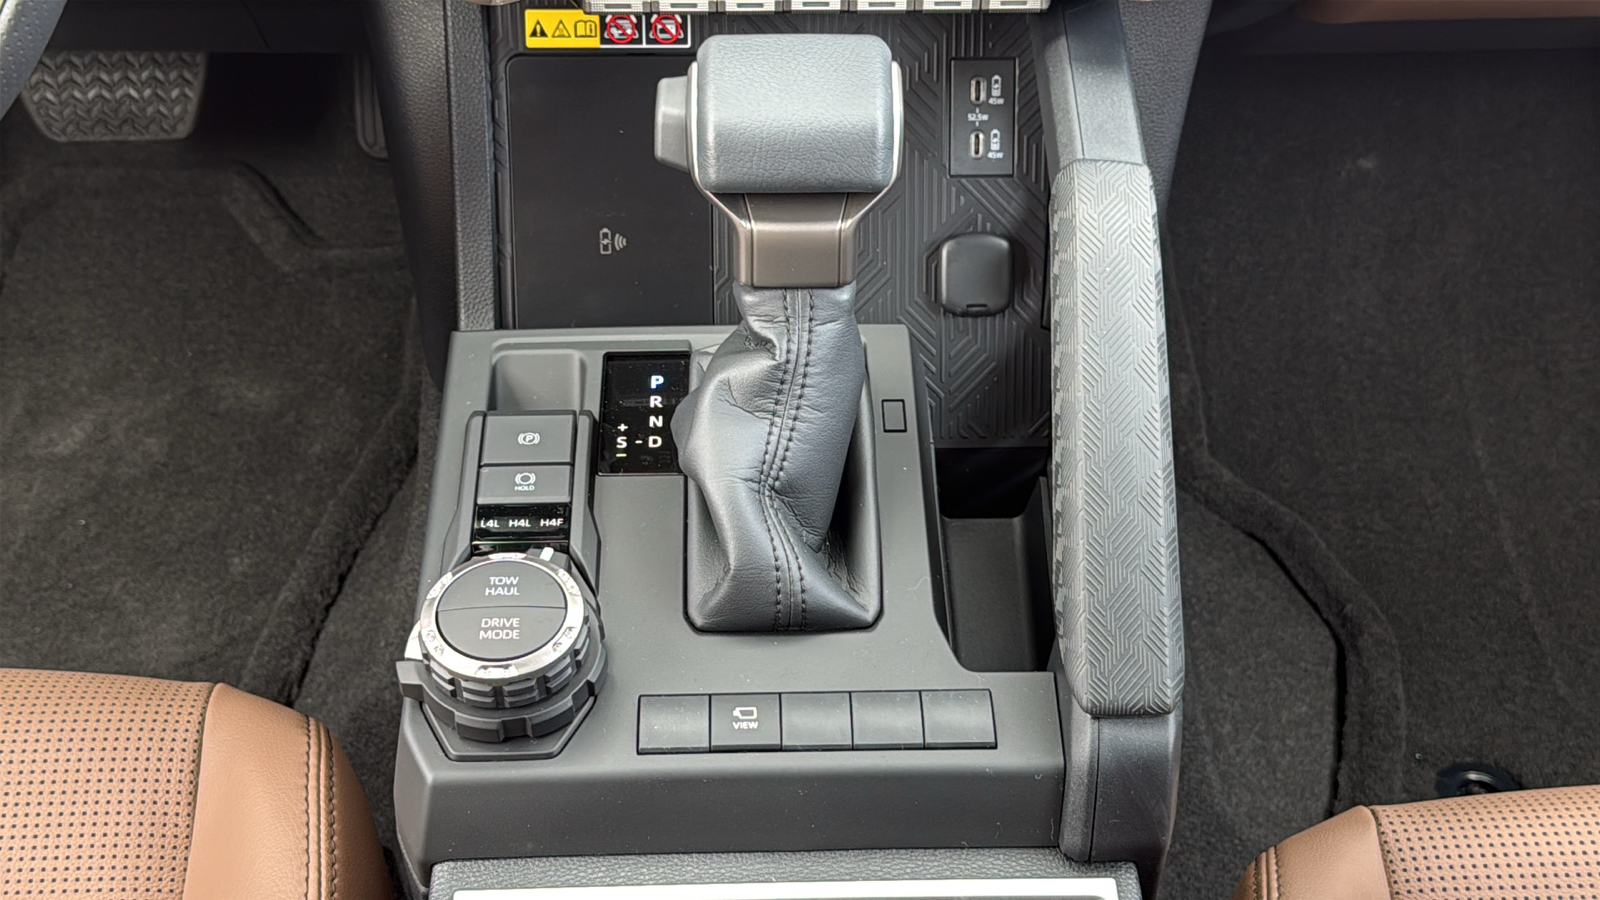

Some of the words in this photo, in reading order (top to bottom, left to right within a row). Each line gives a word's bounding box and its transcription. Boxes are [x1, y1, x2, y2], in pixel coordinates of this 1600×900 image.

[650, 375, 664, 389] P
[649, 395, 663, 408] R
[649, 415, 663, 428] N
[616, 436, 628, 448] S
[648, 435, 662, 448] D
[480, 519, 500, 528] L4L
[508, 519, 531, 527] H4L
[540, 518, 564, 527] H4F
[489, 576, 519, 585] TOW
[485, 587, 520, 596] HAUL
[481, 617, 520, 628] DRIVE
[479, 630, 520, 640] MODE
[732, 721, 758, 730] VIEW
